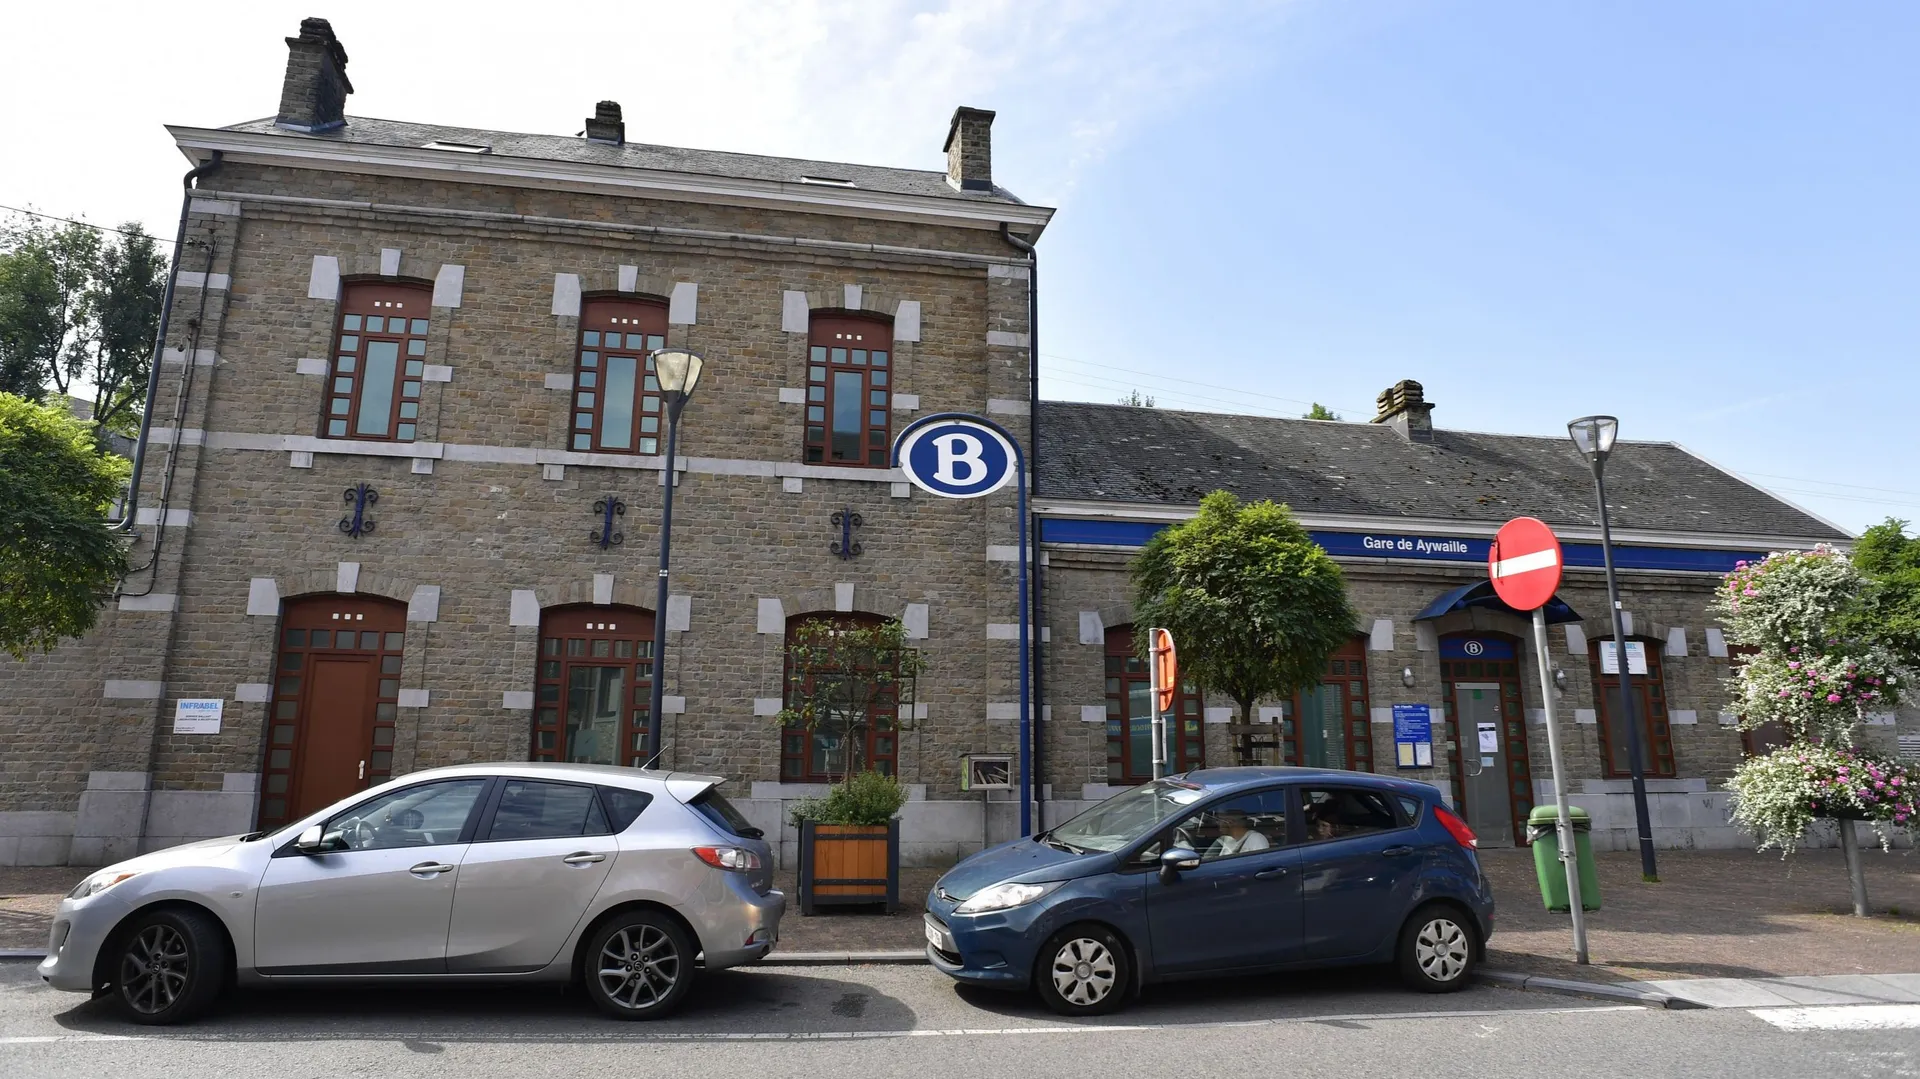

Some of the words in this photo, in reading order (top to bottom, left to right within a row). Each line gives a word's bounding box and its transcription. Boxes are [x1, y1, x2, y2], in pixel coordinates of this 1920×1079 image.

[931, 433, 988, 486] B
[1363, 536, 1394, 549] Gare
[1397, 538, 1413, 551] de
[1416, 539, 1468, 554] Aywaille
[1469, 643, 1479, 653] B
